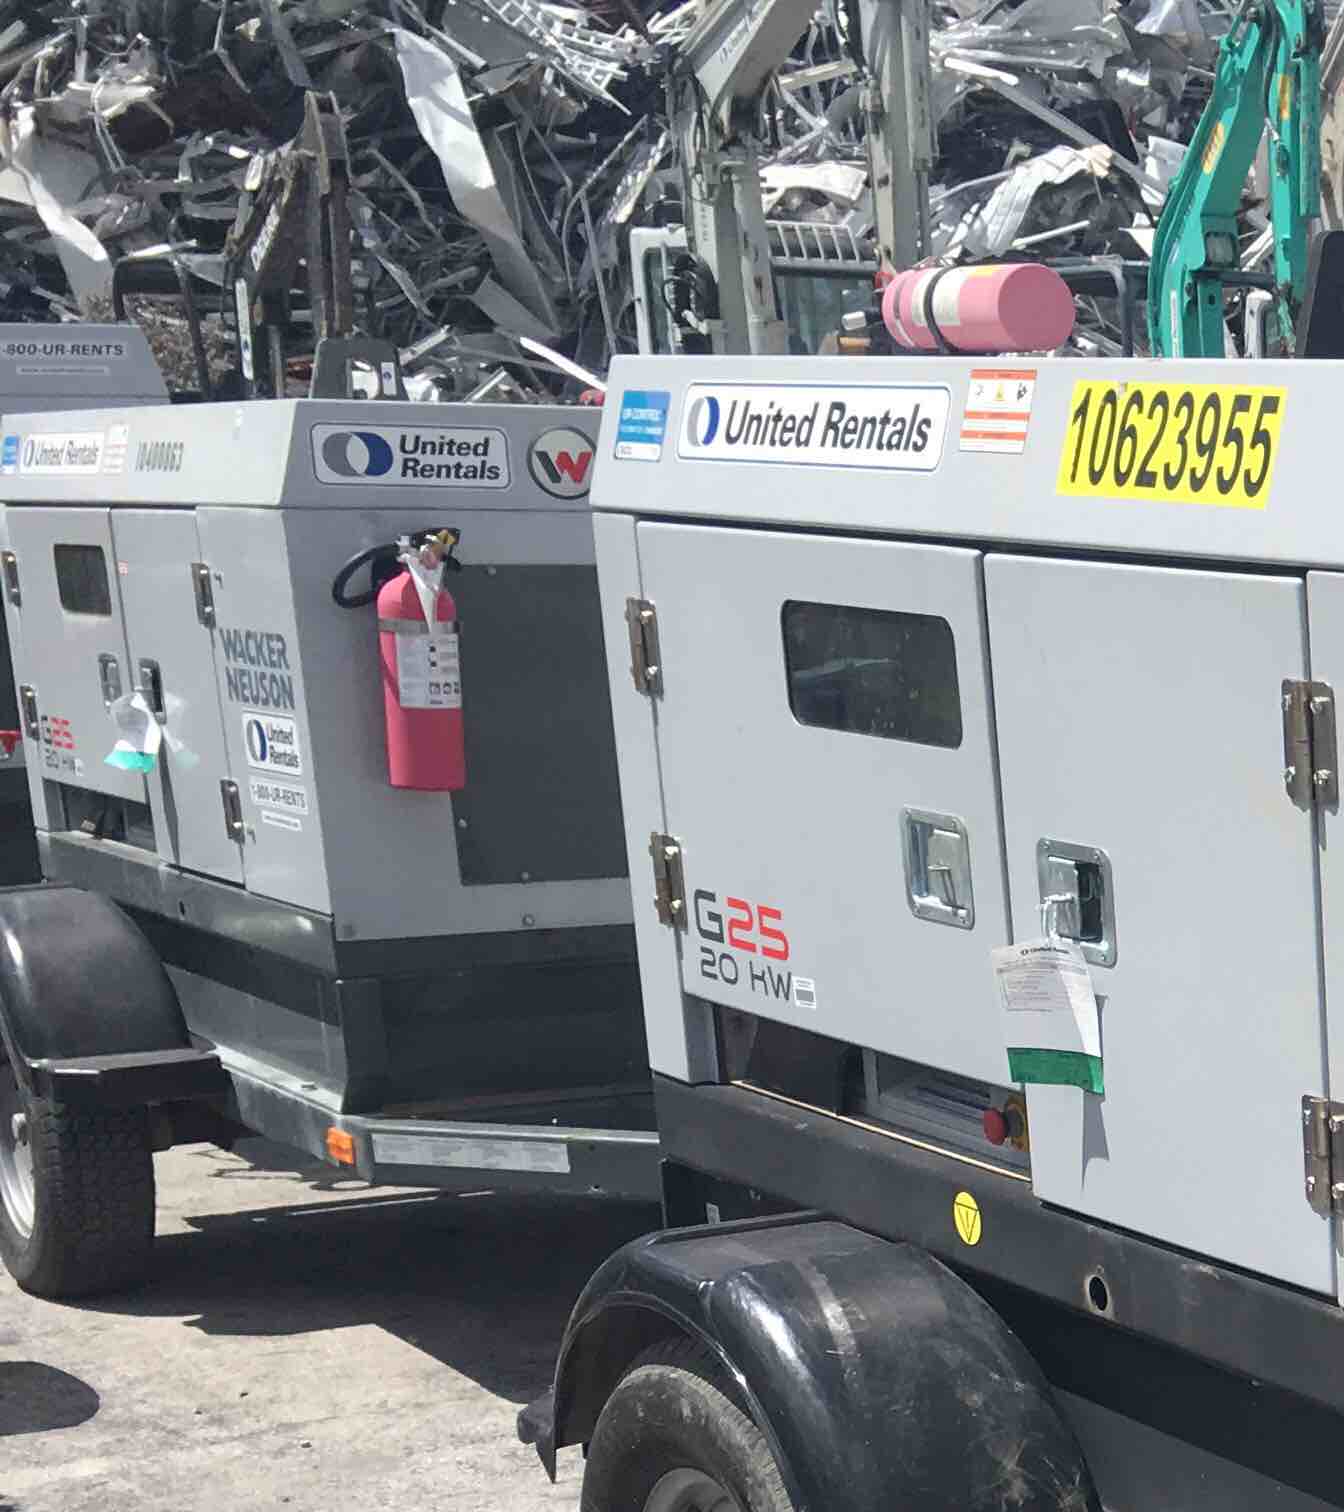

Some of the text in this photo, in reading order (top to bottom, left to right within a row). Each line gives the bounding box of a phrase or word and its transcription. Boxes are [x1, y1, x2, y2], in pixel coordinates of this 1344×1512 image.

[399, 434, 490, 458] United
[725, 399, 819, 448] United
[820, 401, 932, 453] Rentals
[1069, 387, 1281, 498] 10623955
[400, 457, 501, 481] Rentals
[219, 627, 291, 671] WACKER
[224, 666, 296, 711] NEUSON
[265, 722, 294, 746] United
[268, 745, 300, 769] Rentals
[693, 889, 790, 961] G25
[700, 945, 739, 985] 20
